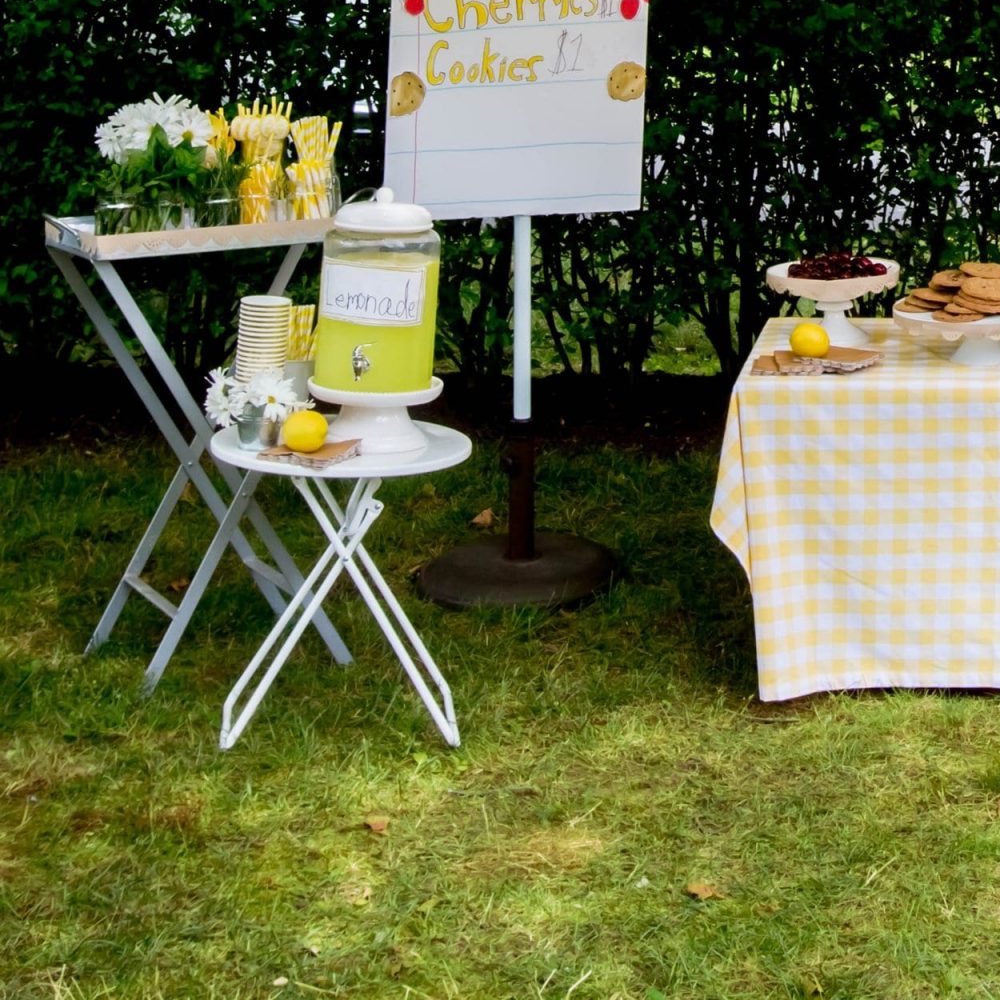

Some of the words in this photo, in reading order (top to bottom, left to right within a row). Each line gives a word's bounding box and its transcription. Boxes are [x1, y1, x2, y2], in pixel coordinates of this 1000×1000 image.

[427, 37, 544, 86] Cookies
[547, 29, 585, 77] $1
[326, 271, 416, 319] Lemonade
